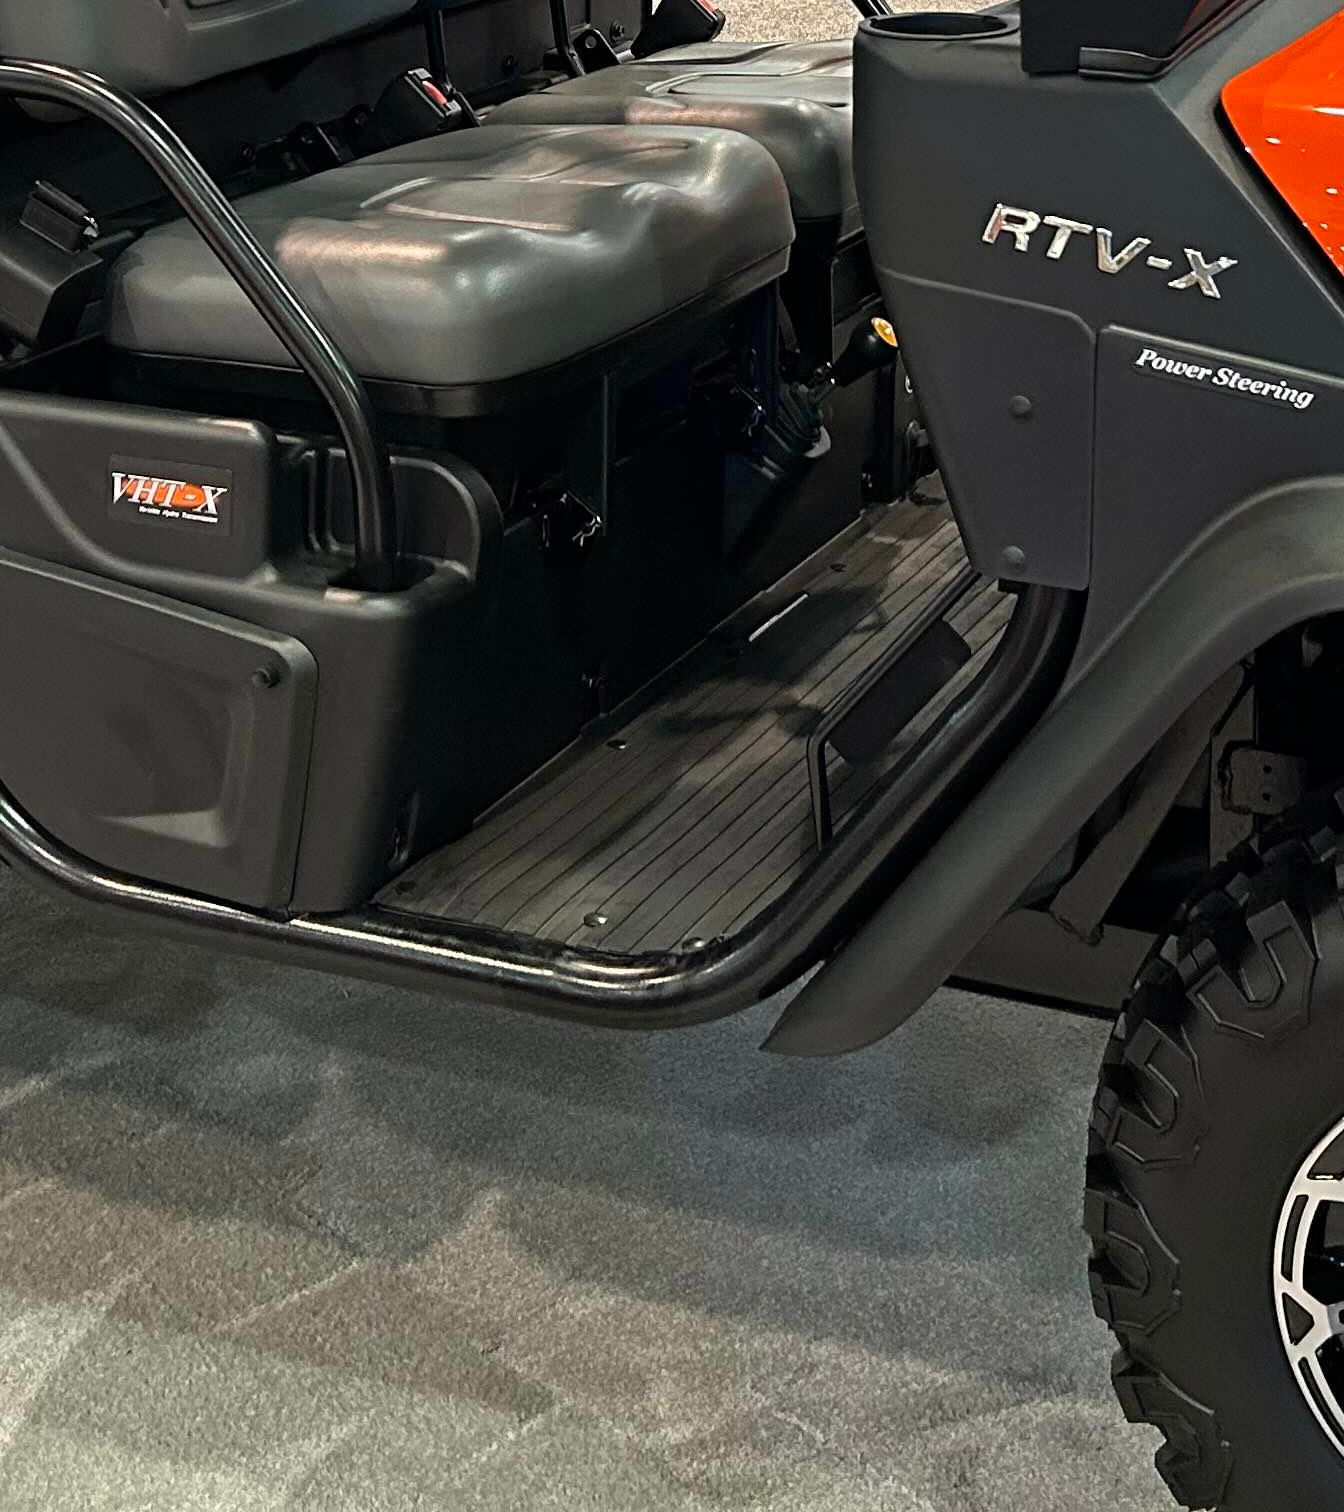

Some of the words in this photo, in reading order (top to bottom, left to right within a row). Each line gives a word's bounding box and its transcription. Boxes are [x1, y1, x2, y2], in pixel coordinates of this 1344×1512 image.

[981, 202, 1239, 300] RTV-X
[1134, 347, 1213, 382] Power
[1212, 366, 1316, 410] Steering
[111, 471, 228, 515] VHT-X
